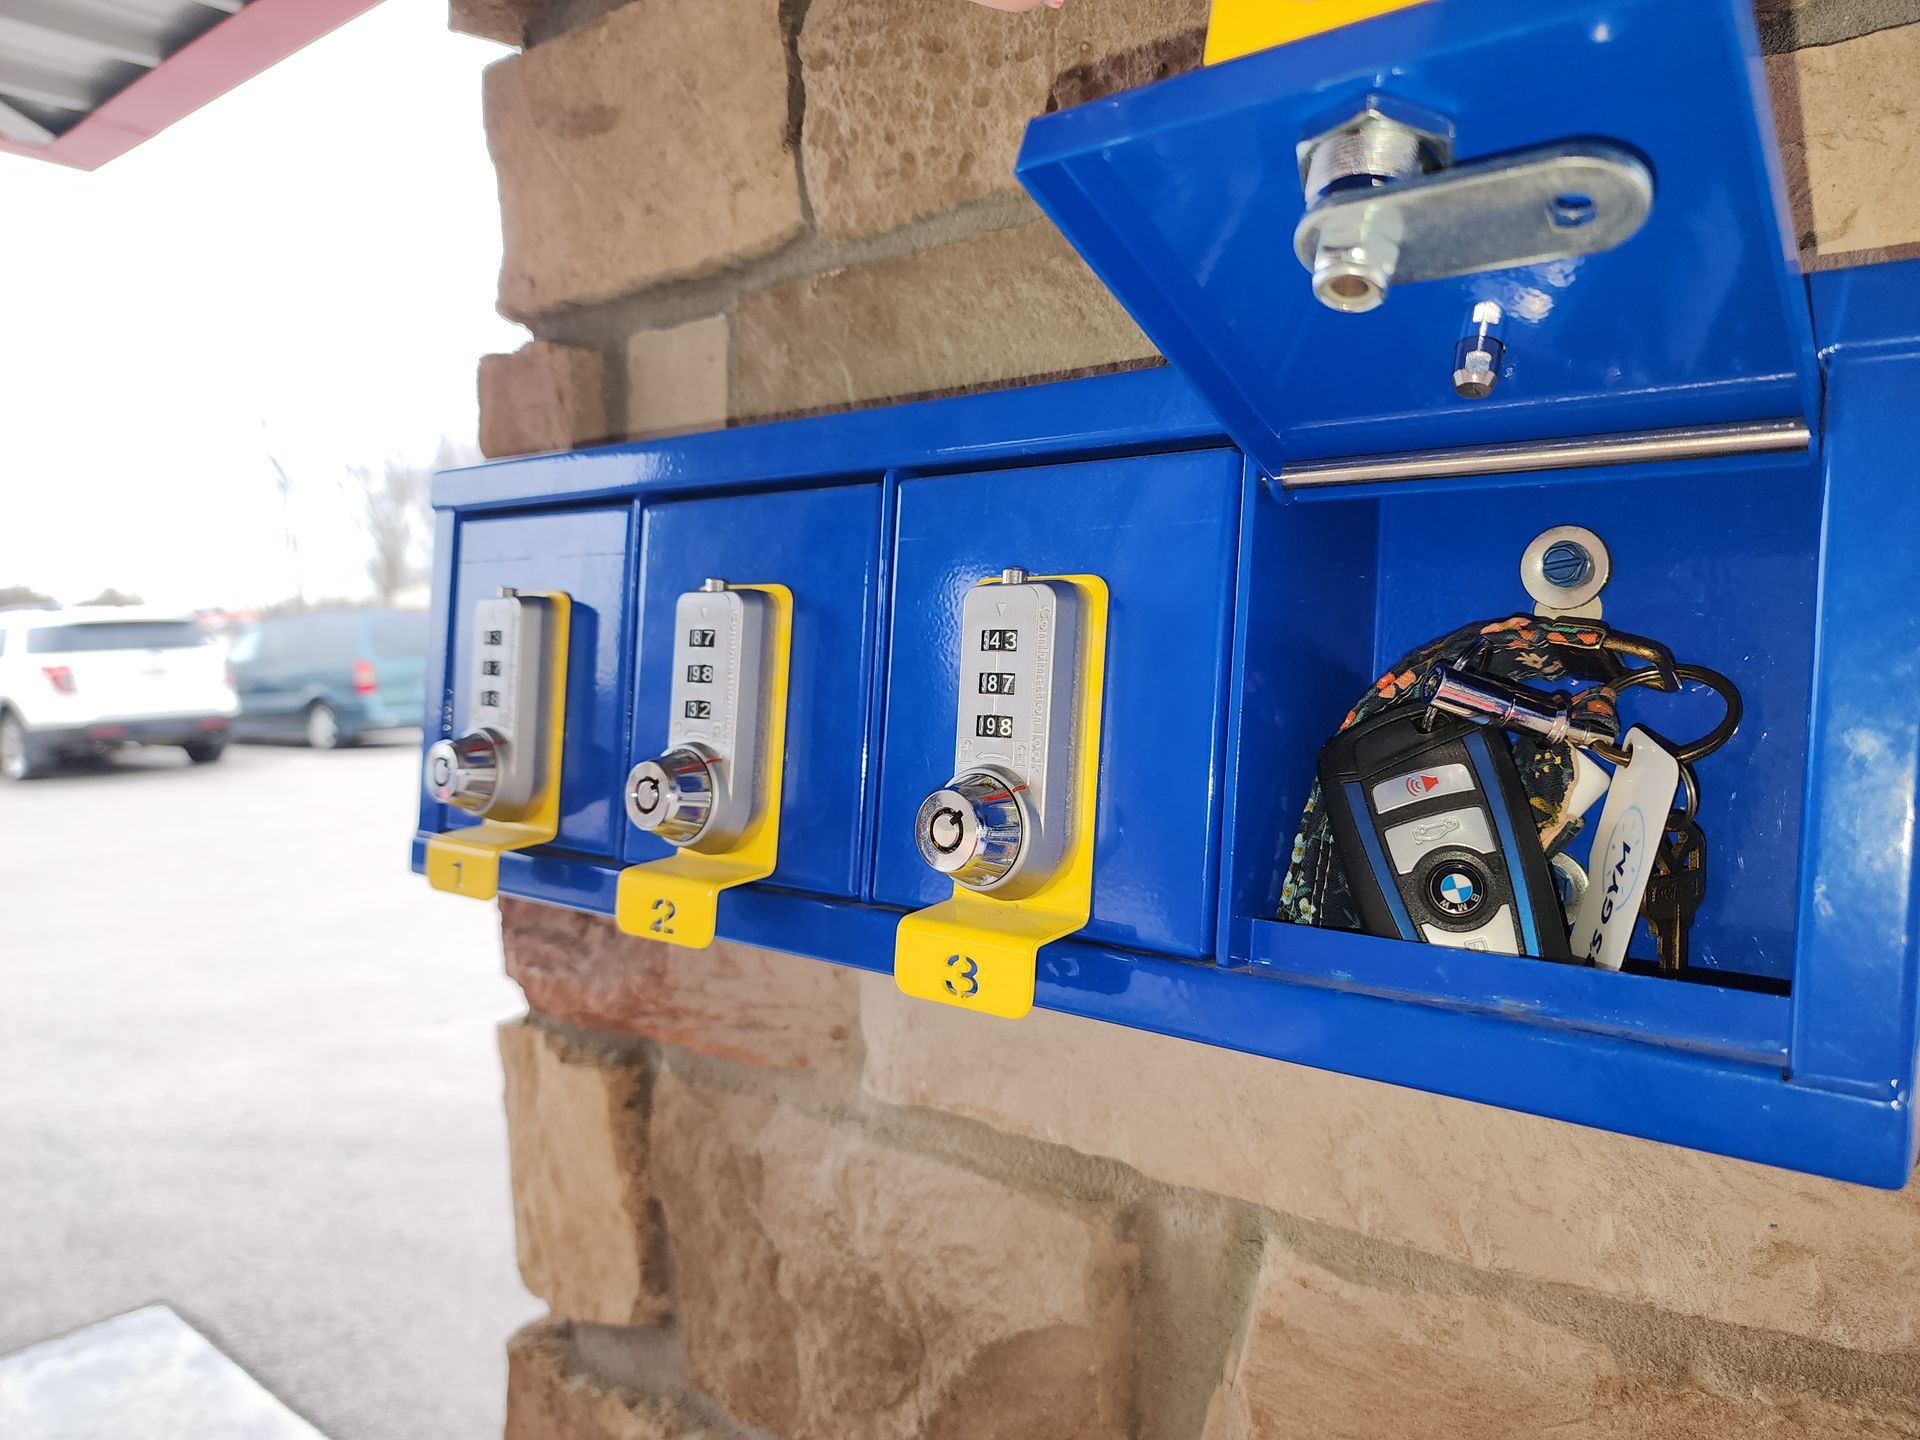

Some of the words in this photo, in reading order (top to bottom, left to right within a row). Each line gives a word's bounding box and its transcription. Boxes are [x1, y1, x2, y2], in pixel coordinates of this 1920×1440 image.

[452, 862, 464, 889] 1
[1602, 841, 1631, 924] GYM
[649, 898, 677, 935] 2
[1439, 892, 1480, 912] BMW
[944, 953, 979, 999] 3
